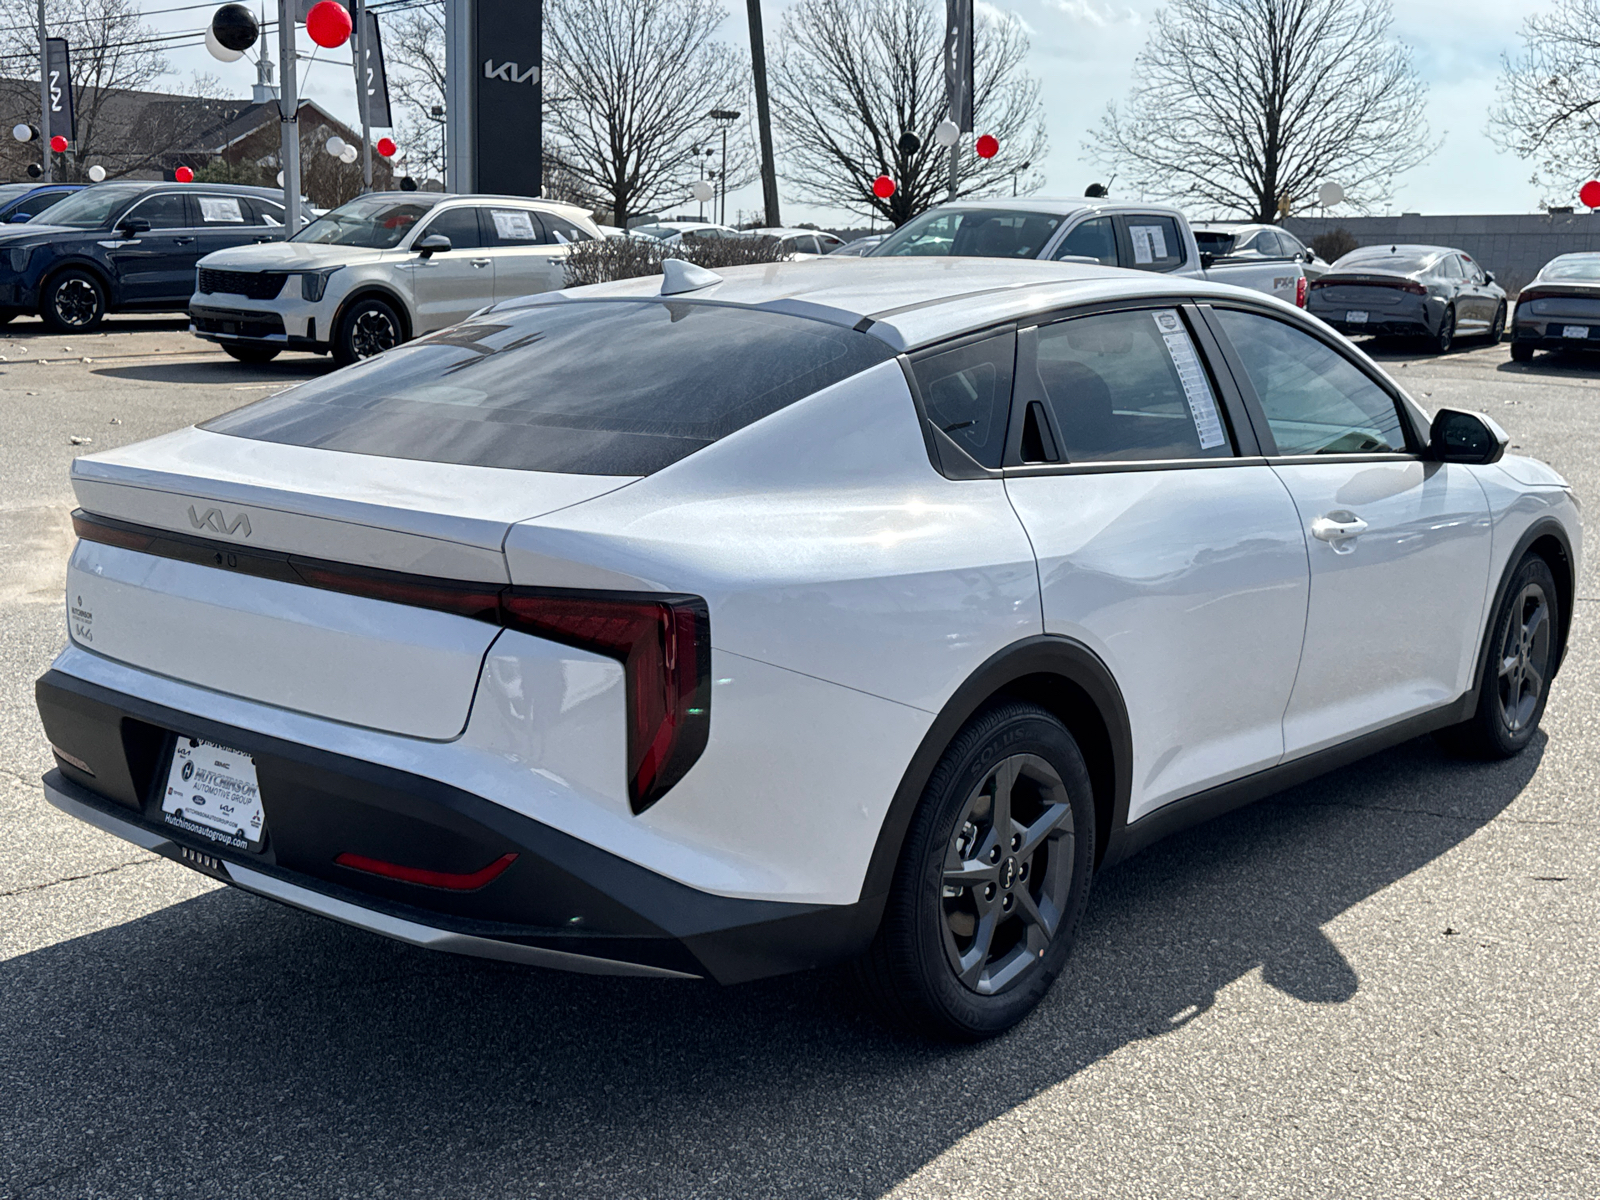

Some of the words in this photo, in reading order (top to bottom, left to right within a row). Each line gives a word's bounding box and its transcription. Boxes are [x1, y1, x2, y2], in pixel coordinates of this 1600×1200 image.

[484, 58, 540, 86] KIA
[1273, 276, 1295, 289] FX4
[187, 504, 252, 538] KIA
[75, 623, 94, 642] K4
[177, 747, 191, 756] KIA
[971, 727, 1025, 777] SOLUS
[214, 760, 231, 770] GMC
[193, 768, 258, 798] HUTCHINSON
[193, 782, 230, 800] AUTOMOTIVE
[230, 794, 253, 806] GROUP
[193, 796, 206, 805] Ford
[219, 803, 235, 813] KIA
[185, 807, 239, 829] HUTCHINSONAUTOGROUP.COM
[164, 813, 248, 850] Hutchinsonautogroup.com
